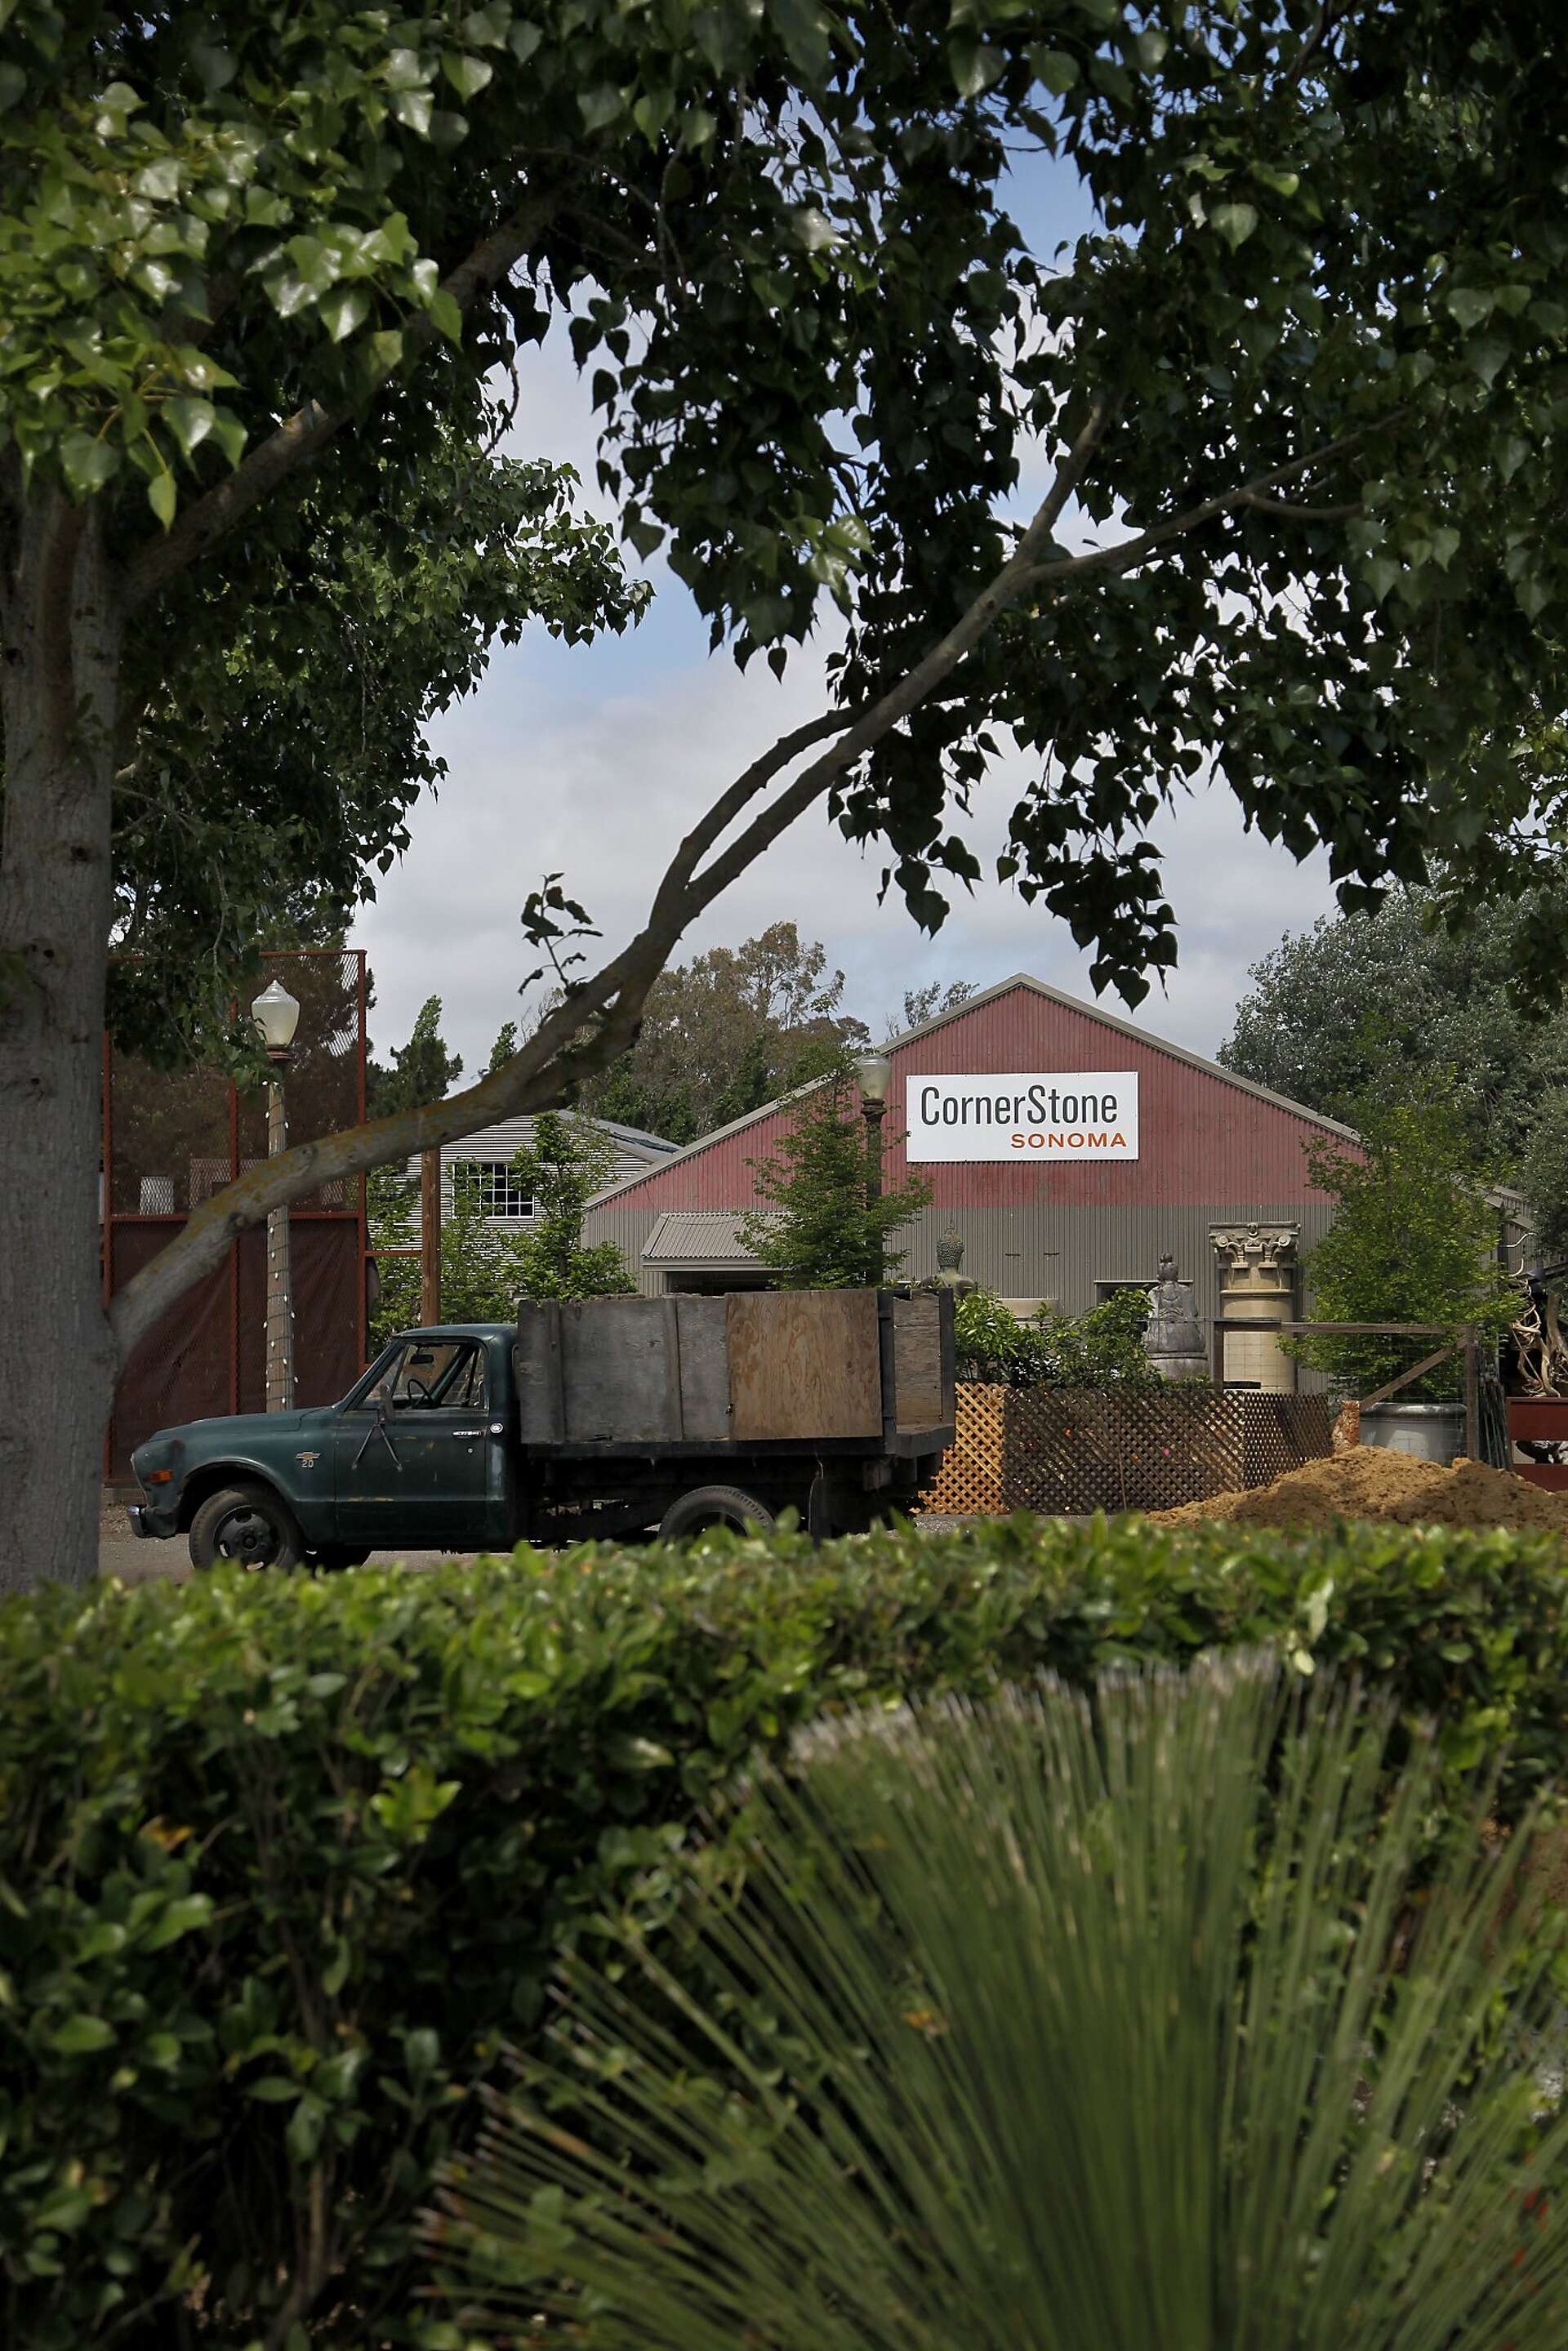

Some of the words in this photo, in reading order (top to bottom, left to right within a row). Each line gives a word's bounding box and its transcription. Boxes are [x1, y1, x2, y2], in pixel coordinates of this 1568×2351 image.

[921, 1084, 1117, 1125] CornerStone
[1011, 1132, 1126, 1149] SONOMA
[302, 1459, 314, 1468] 20
